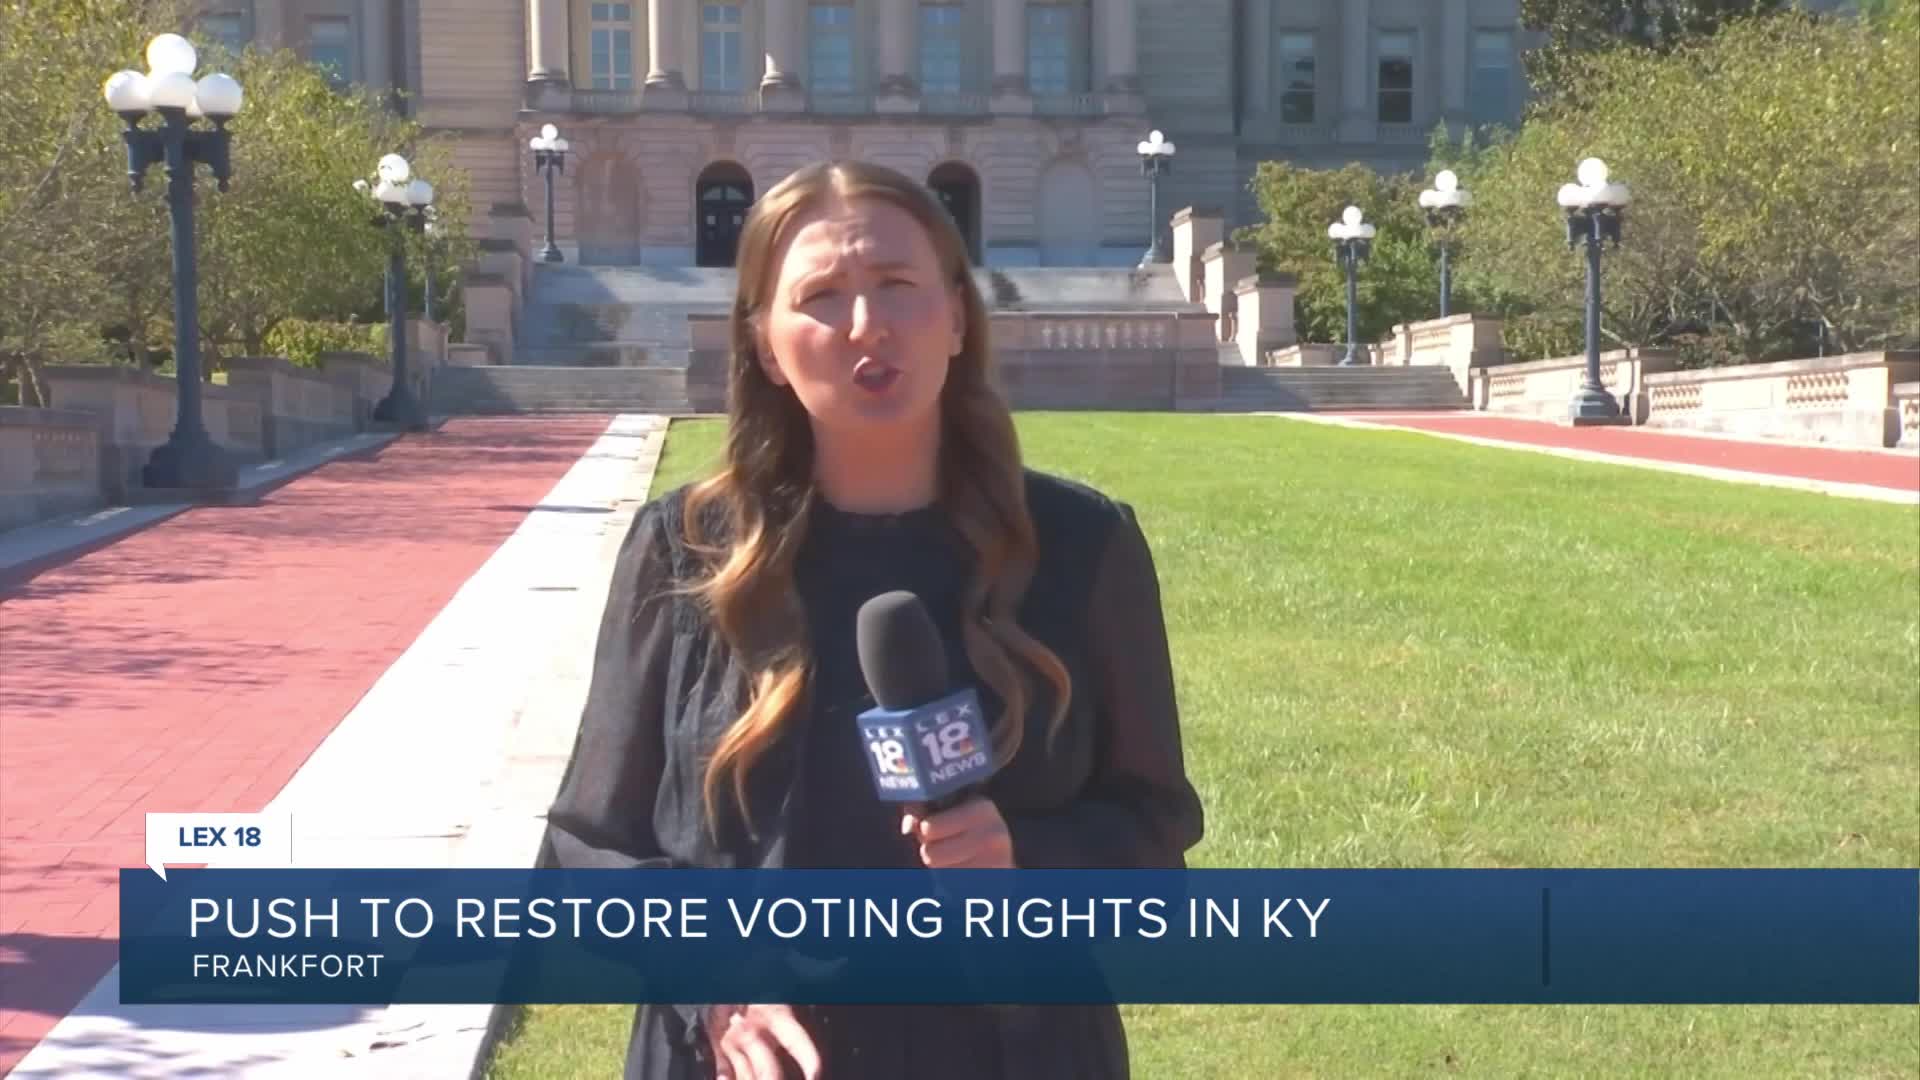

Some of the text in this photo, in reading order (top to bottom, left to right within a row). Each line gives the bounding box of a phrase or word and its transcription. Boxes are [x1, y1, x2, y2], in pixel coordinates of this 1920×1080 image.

[915, 704, 972, 732] LEX
[870, 740, 907, 774] 18
[922, 721, 970, 766] 18
[879, 775, 920, 790] NEWS
[929, 752, 987, 783] NEWS
